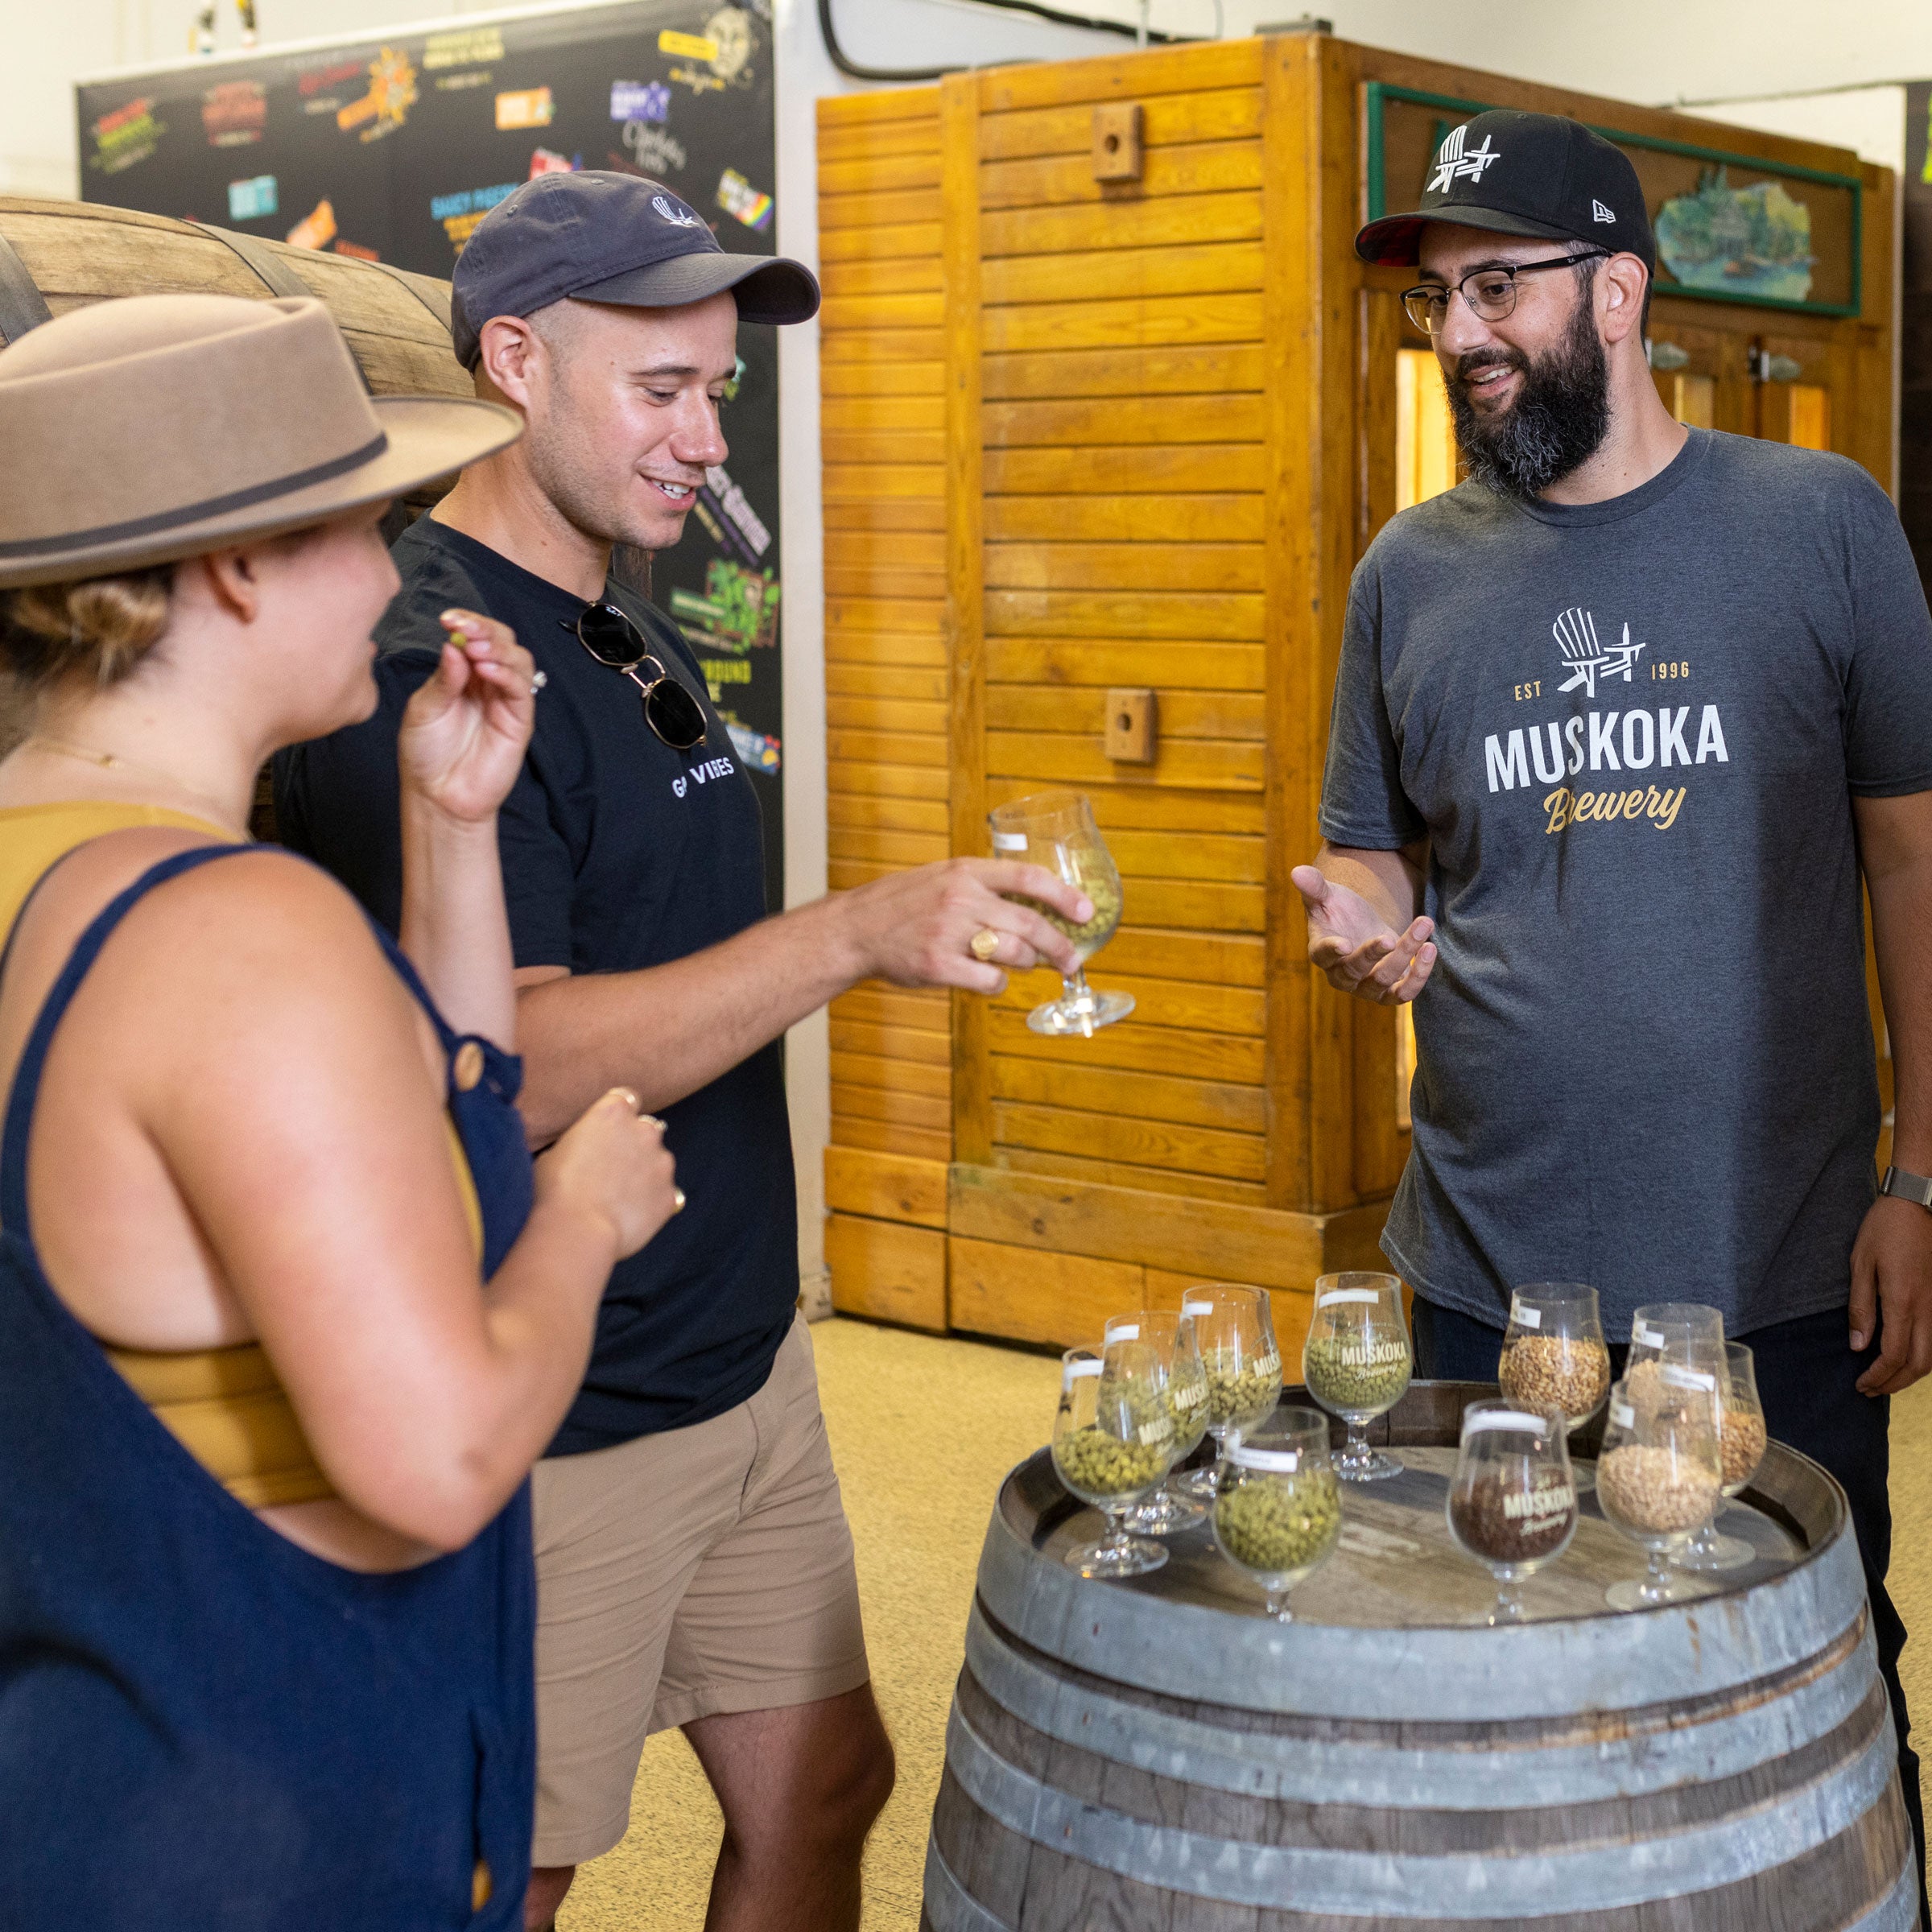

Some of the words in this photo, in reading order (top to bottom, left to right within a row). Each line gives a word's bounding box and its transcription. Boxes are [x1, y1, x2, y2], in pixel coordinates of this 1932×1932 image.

[1514, 680, 1542, 701] EST
[1651, 661, 1690, 680] 1996
[1484, 704, 1729, 793] MUSKOKA
[1543, 784, 1687, 835] Brewery
[1341, 1341, 1407, 1367] MUSKOKA
